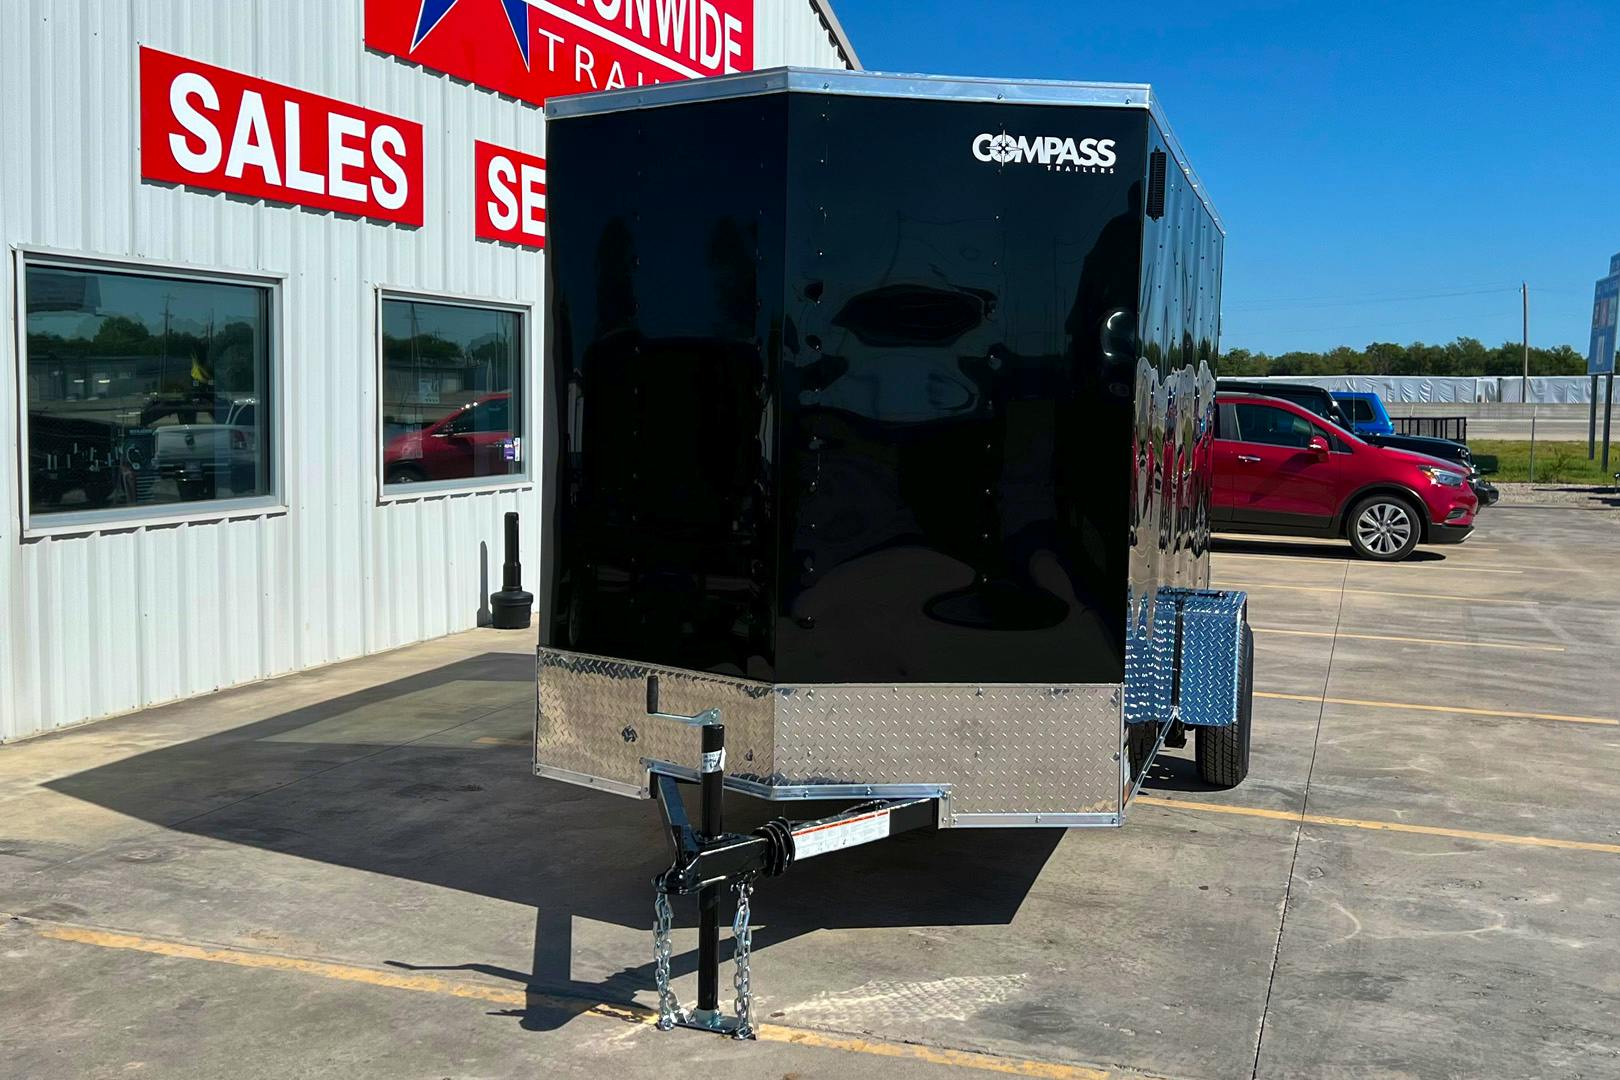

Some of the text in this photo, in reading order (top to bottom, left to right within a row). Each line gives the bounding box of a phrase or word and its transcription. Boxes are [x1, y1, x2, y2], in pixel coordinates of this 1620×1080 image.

[538, 28, 660, 91] TRA
[168, 72, 409, 211] SALES
[972, 132, 1117, 168] COMPASS
[1046, 165, 1115, 174] TRAILERS
[487, 155, 546, 237] SE
